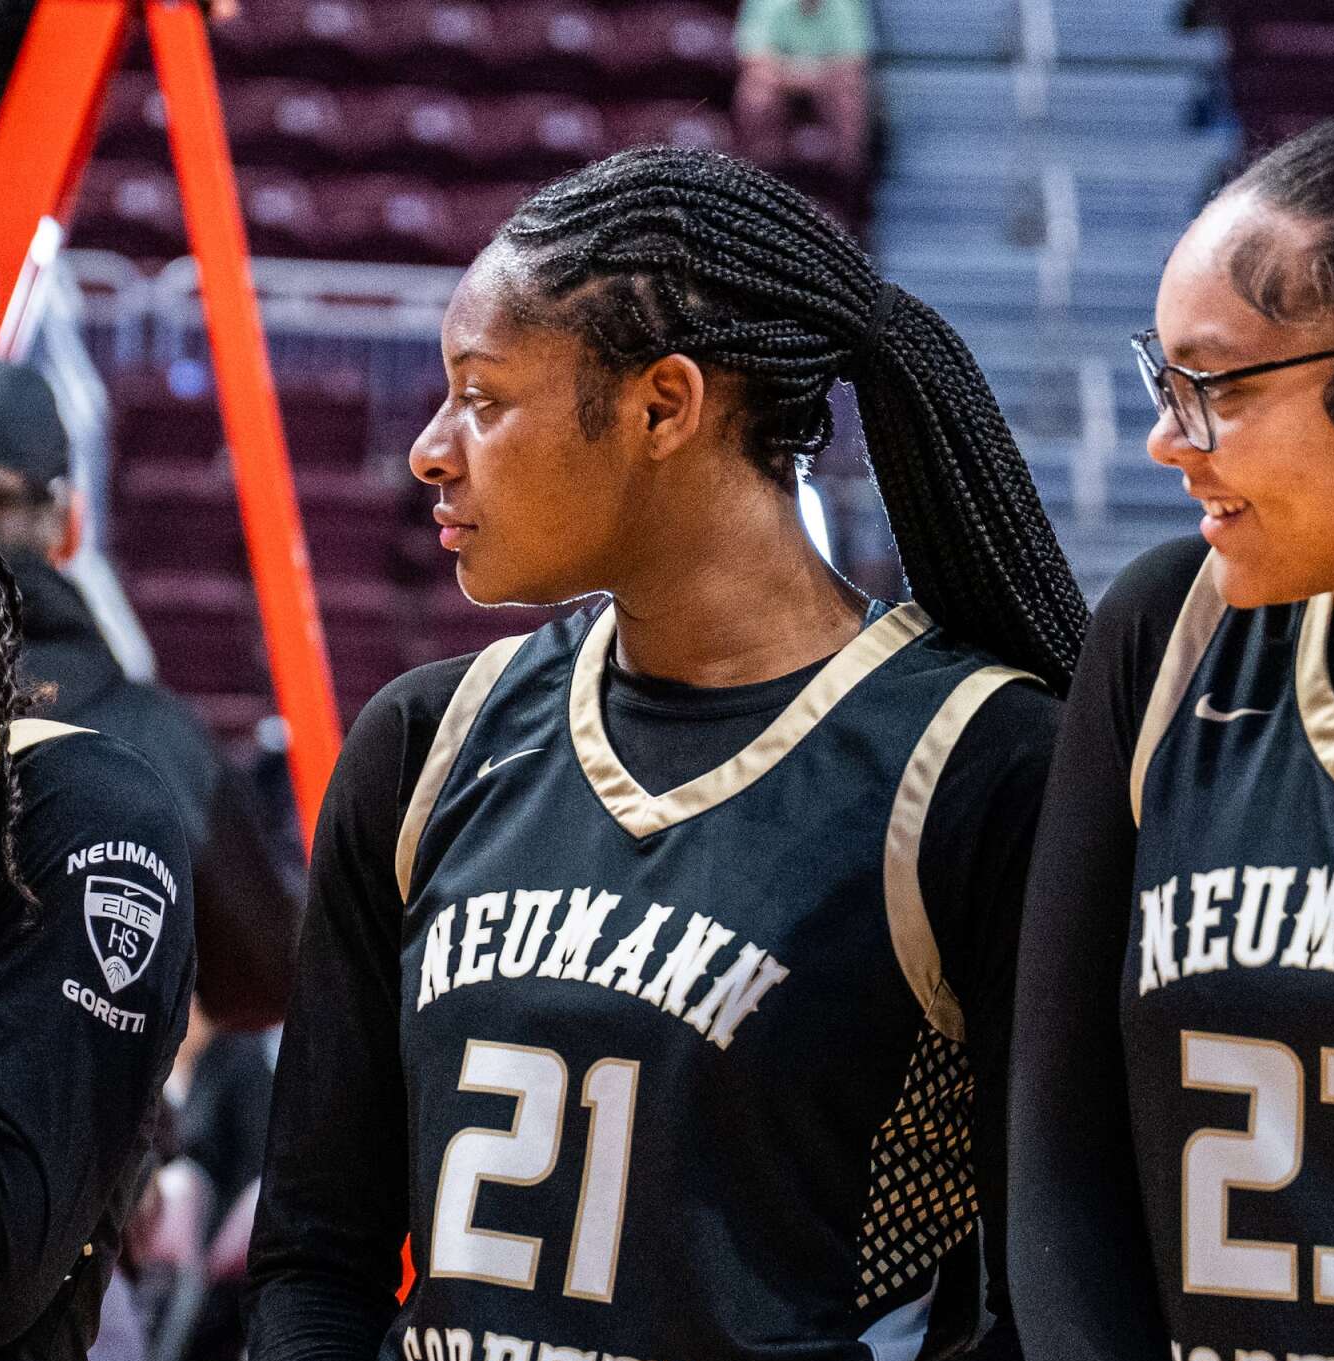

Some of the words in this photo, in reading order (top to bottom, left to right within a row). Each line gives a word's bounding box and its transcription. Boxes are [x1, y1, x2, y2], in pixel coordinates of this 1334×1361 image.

[67, 841, 177, 904] NEUMANN
[108, 922, 140, 959] HS
[417, 886, 789, 1050] NEUMANN
[62, 978, 146, 1033] GORETTI
[429, 1037, 641, 1304] 21
